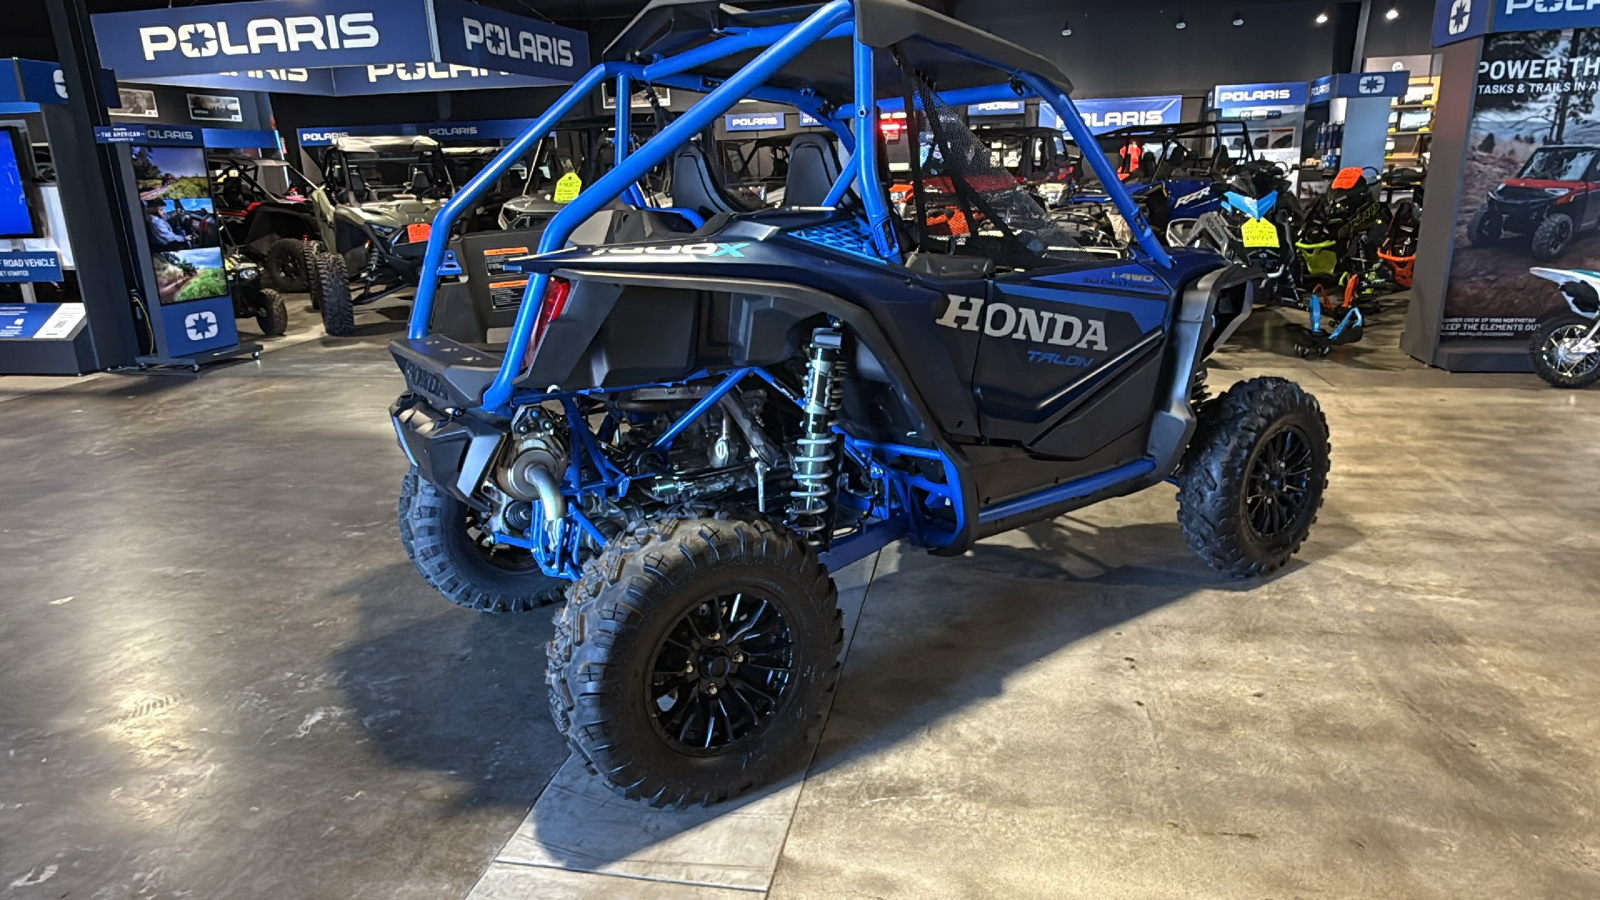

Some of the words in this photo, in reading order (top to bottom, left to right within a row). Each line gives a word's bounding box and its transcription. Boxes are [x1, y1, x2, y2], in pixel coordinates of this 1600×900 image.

[139, 12, 380, 61] POLARIS
[462, 17, 573, 68] POLARIS
[1478, 59, 1560, 80] POWER
[1311, 83, 1330, 96] POLARIS
[1478, 84, 1514, 95] TASKS
[1516, 83, 1526, 93] &
[1529, 81, 1572, 93] TRAILS
[1573, 81, 1586, 92] IN
[1220, 89, 1290, 103] POLARIS
[732, 116, 778, 127] POLARIS
[147, 129, 194, 141] OLARIS
[428, 126, 477, 136] POLARIS
[3, 259, 24, 267] ROAD
[25, 258, 56, 267] VEHICLE
[935, 294, 1108, 352] HONDA
[1027, 351, 1095, 368] TALON
